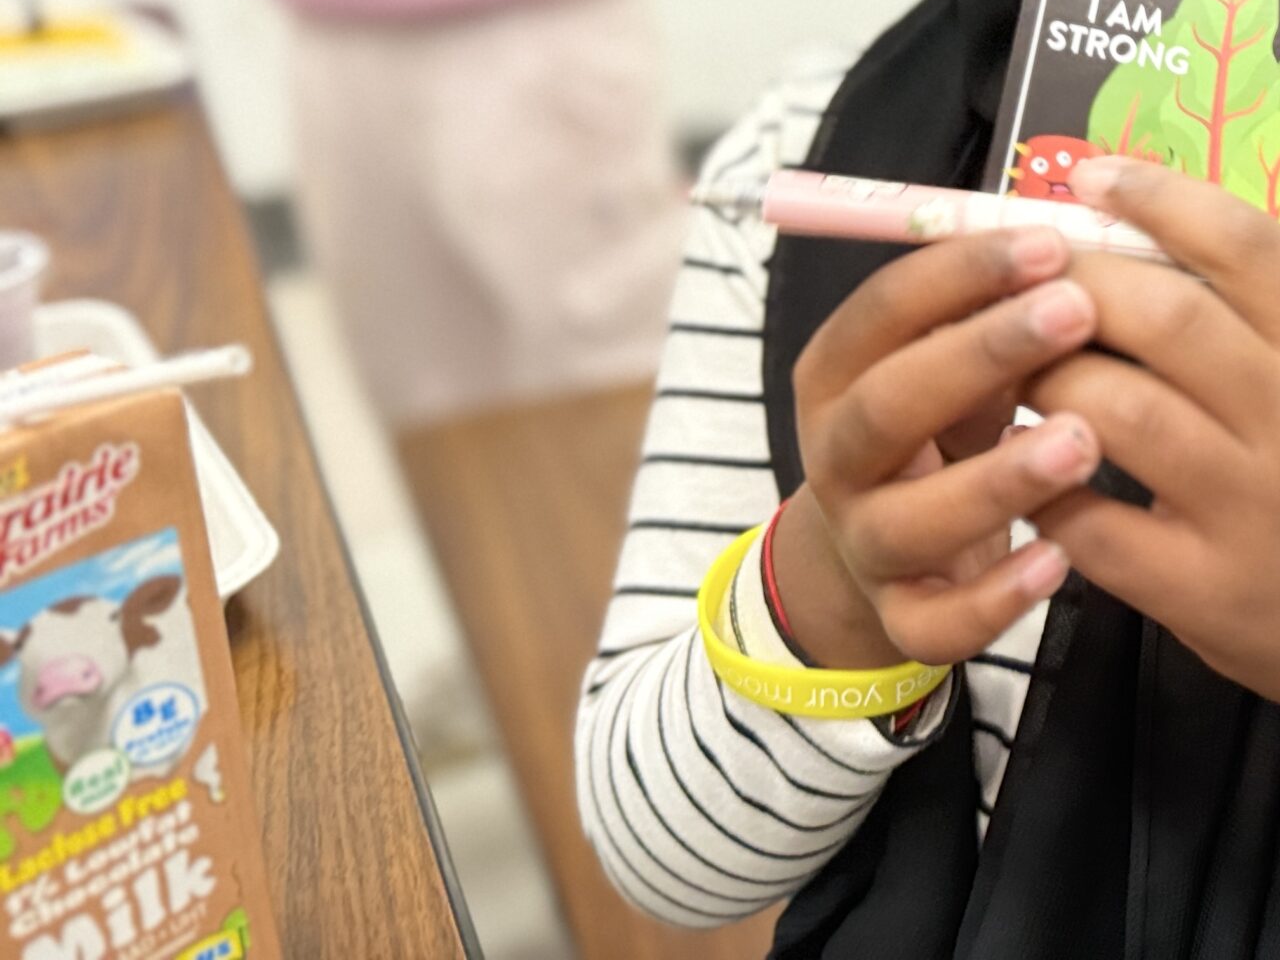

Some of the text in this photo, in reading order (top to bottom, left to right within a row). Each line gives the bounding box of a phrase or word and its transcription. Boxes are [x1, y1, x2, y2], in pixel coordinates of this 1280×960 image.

[1106, 0, 1163, 36] AM
[1046, 20, 1192, 76] STRONG
[0, 448, 134, 543] rairie
[803, 681, 884, 709] your
[117, 776, 188, 828] Free
[8, 823, 201, 937] Chocolate
[22, 849, 217, 960] Milk
